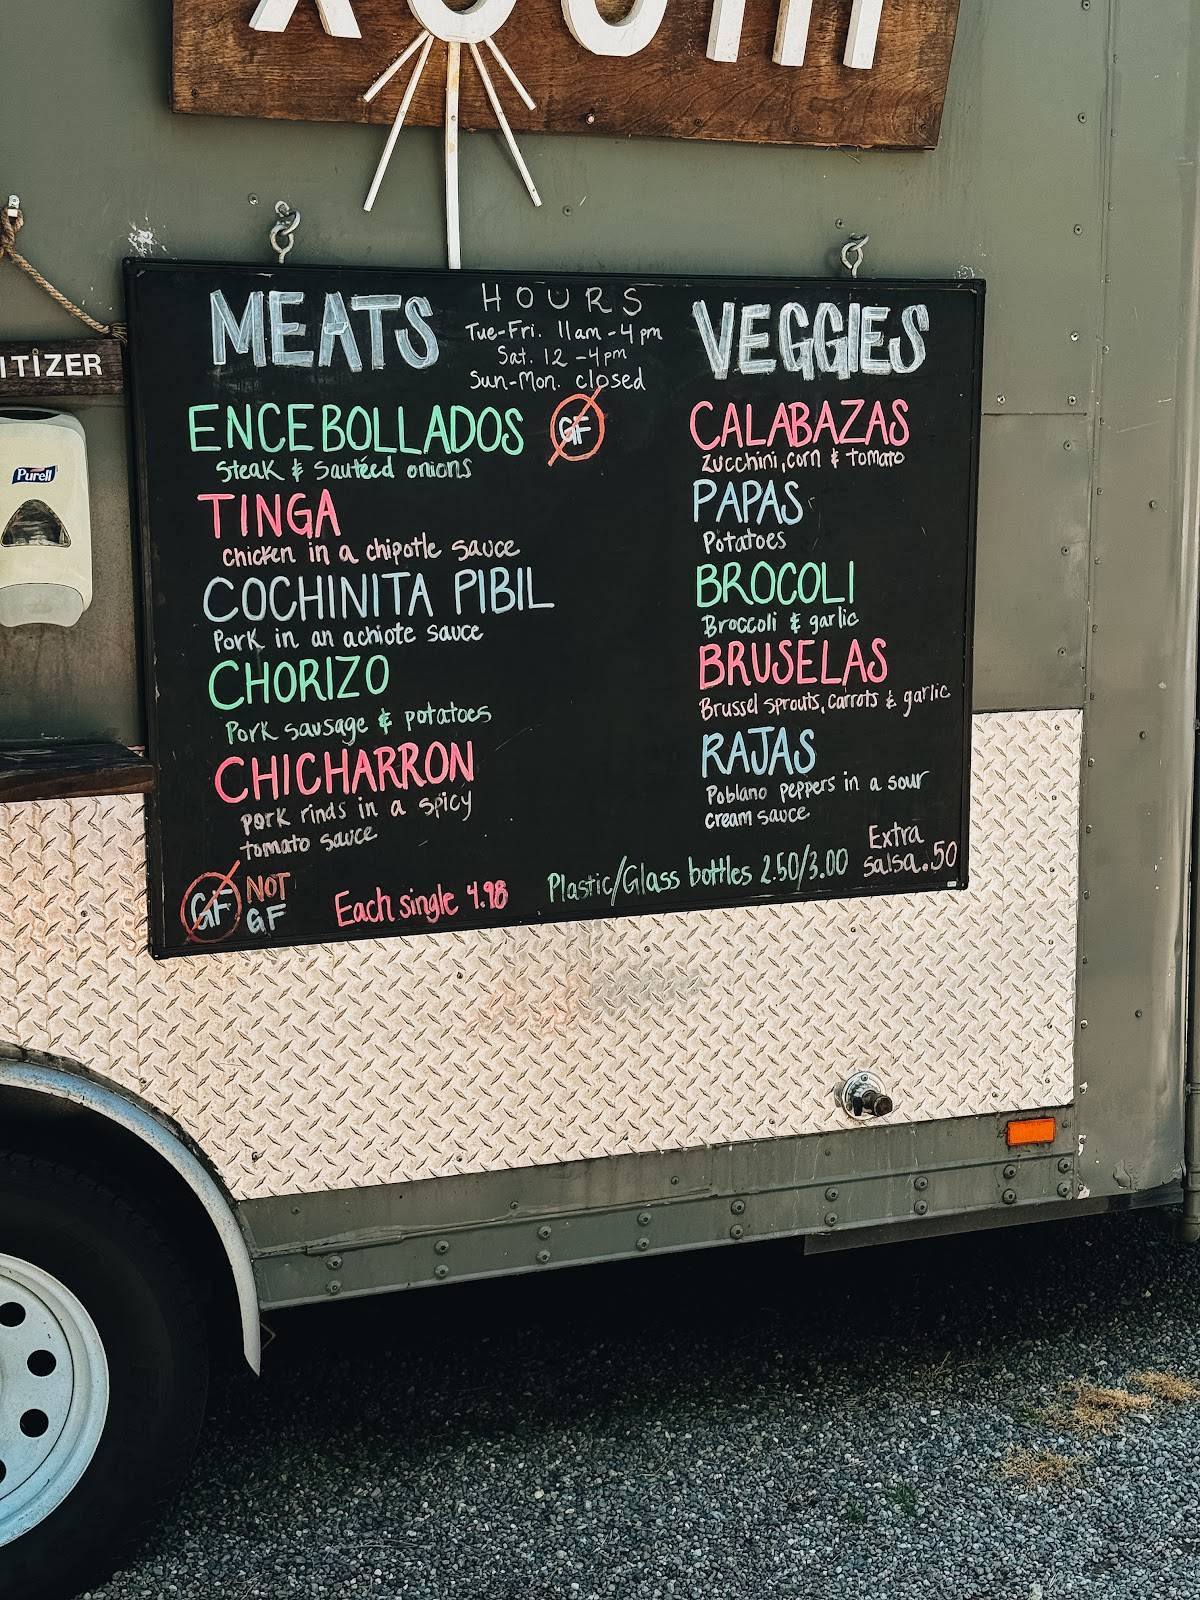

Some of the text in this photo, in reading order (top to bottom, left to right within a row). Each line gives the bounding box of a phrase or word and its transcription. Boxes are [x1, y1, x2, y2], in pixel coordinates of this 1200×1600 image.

[210, 290, 439, 372] MEATS
[692, 300, 930, 381] VEGGIES
[498, 345, 532, 365] Sat.
[575, 367, 647, 391] closed
[189, 403, 524, 455] ENCEBOLLADOS
[557, 415, 592, 446] GF
[690, 399, 909, 450] CALABAZAS
[407, 458, 472, 478] onions
[846, 448, 905, 467] tomato
[16, 468, 53, 483] Purell
[197, 489, 341, 539] TINGA
[693, 479, 803, 525] PAPAS
[309, 542, 330, 565] in
[339, 545, 359, 564] a
[366, 532, 442, 565] chipotle
[452, 540, 520, 561] sauce
[703, 528, 786, 554] Potatoes
[204, 567, 554, 622] COCHINITA PIBIL
[696, 560, 855, 608] BROCOLI
[214, 622, 483, 653] Pork in an achiote sauce
[702, 612, 777, 638] Broccoli
[810, 606, 859, 634] garlic
[700, 638, 887, 692] BRUSELAS
[209, 655, 389, 710] CHORIZO
[699, 693, 758, 721] Brussel
[903, 685, 950, 717] garlic
[226, 721, 278, 744] Pork
[285, 717, 368, 746] sausage
[405, 702, 491, 731] potatoes
[702, 726, 815, 778] RAJAS
[213, 741, 475, 804] CHICHARRON
[706, 771, 929, 805] Poblano peppers in a sour
[301, 802, 346, 823] rinds
[358, 797, 378, 819] in
[391, 800, 406, 816] a
[419, 791, 471, 821] spicy
[705, 807, 810, 829] cream sauce
[240, 827, 377, 860] tomato sauce
[869, 822, 924, 848] Extra
[247, 872, 290, 903] NOT
[689, 855, 752, 887] bottles
[190, 887, 234, 931] GF
[245, 902, 288, 936] GF
[335, 880, 508, 927] Each single 4.98
